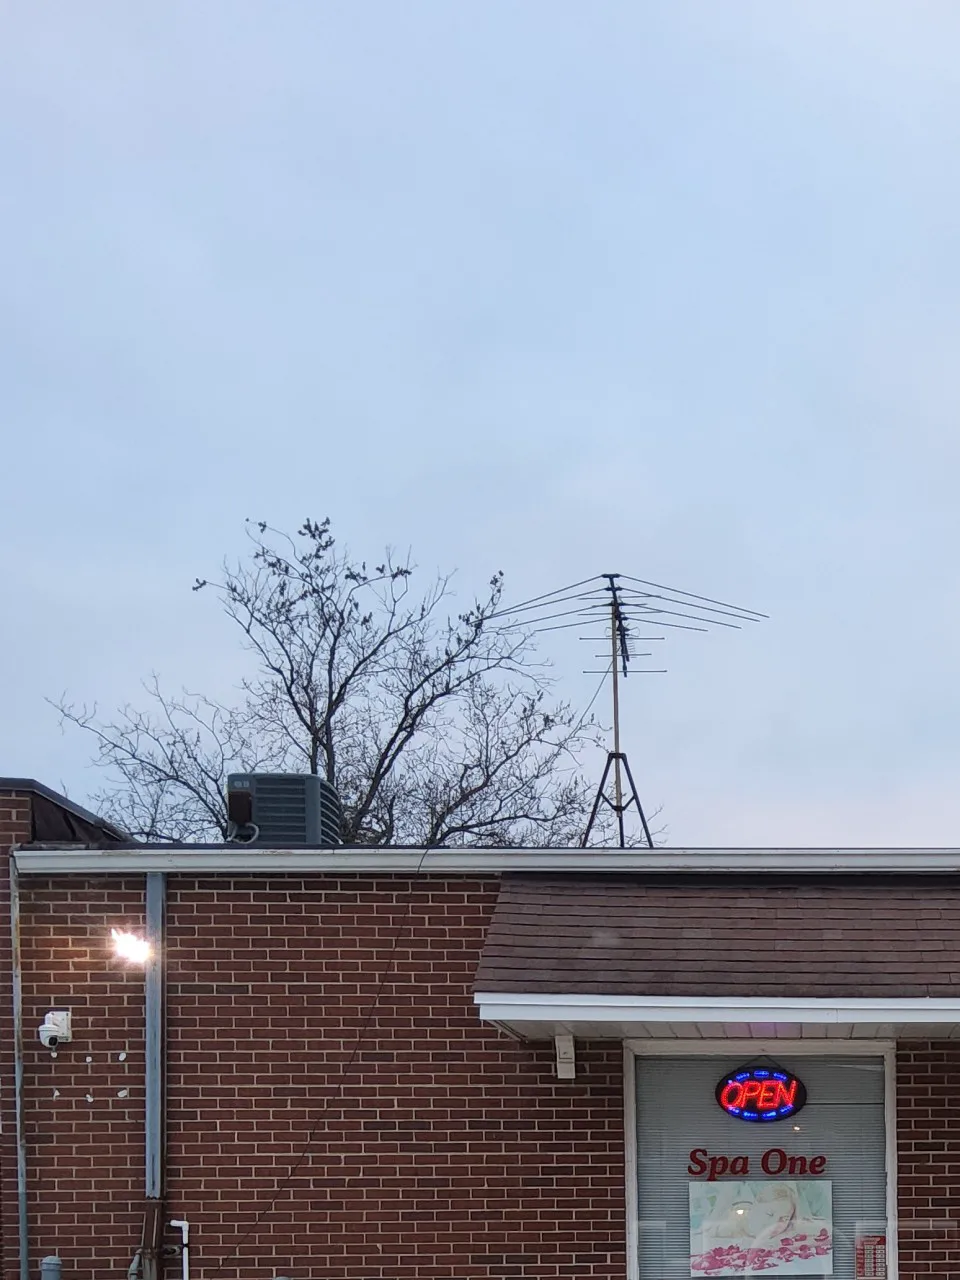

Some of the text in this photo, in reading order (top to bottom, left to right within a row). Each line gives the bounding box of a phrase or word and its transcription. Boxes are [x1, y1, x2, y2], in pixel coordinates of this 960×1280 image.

[721, 1080, 797, 1110] OPEN
[687, 1148, 827, 1181] Spa One
